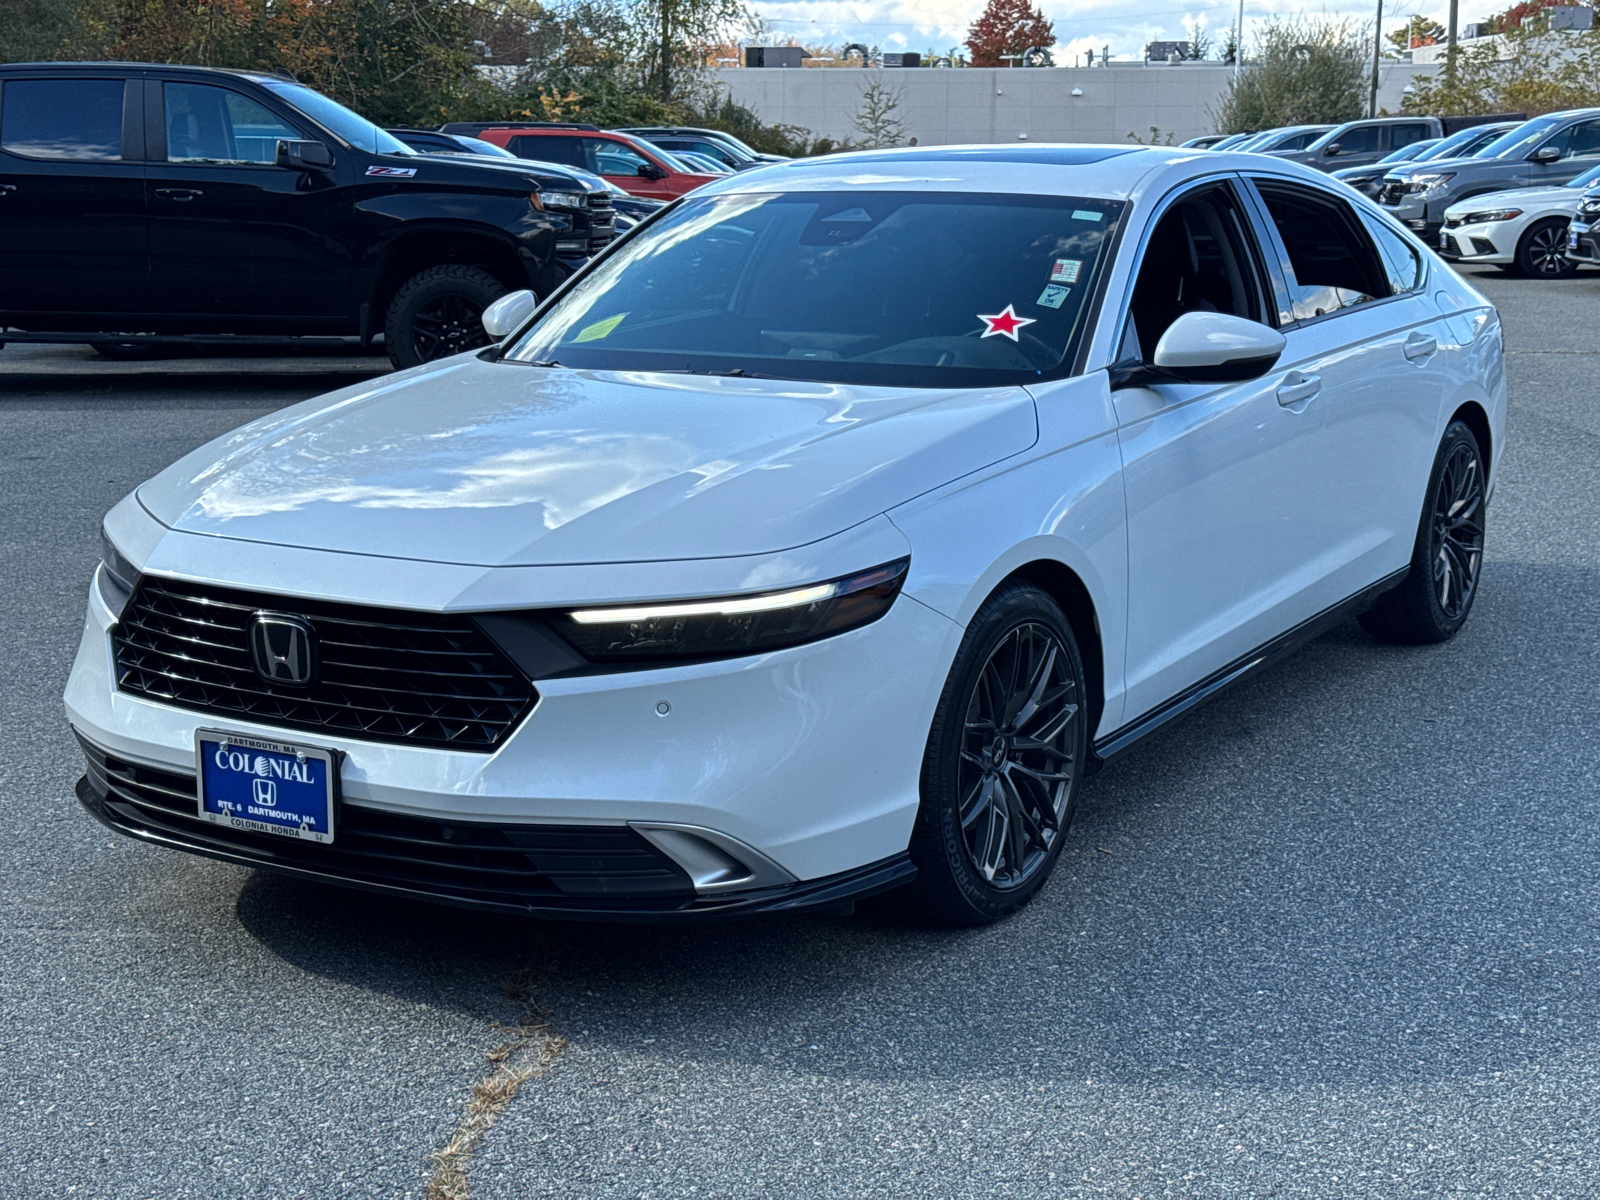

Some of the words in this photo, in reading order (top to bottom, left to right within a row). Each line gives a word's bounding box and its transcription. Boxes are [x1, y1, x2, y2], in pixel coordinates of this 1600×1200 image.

[365, 165, 418, 178] Z71
[1047, 285, 1069, 293] SAFETY
[283, 744, 297, 754] MA
[215, 750, 315, 784] COLONIAL
[217, 799, 235, 811] RTE.
[236, 803, 242, 812] 6
[248, 805, 301, 823] DARTMOUTH,
[302, 815, 316, 825] MA
[230, 817, 269, 832] COLONIAL
[271, 824, 300, 838] HONDA
